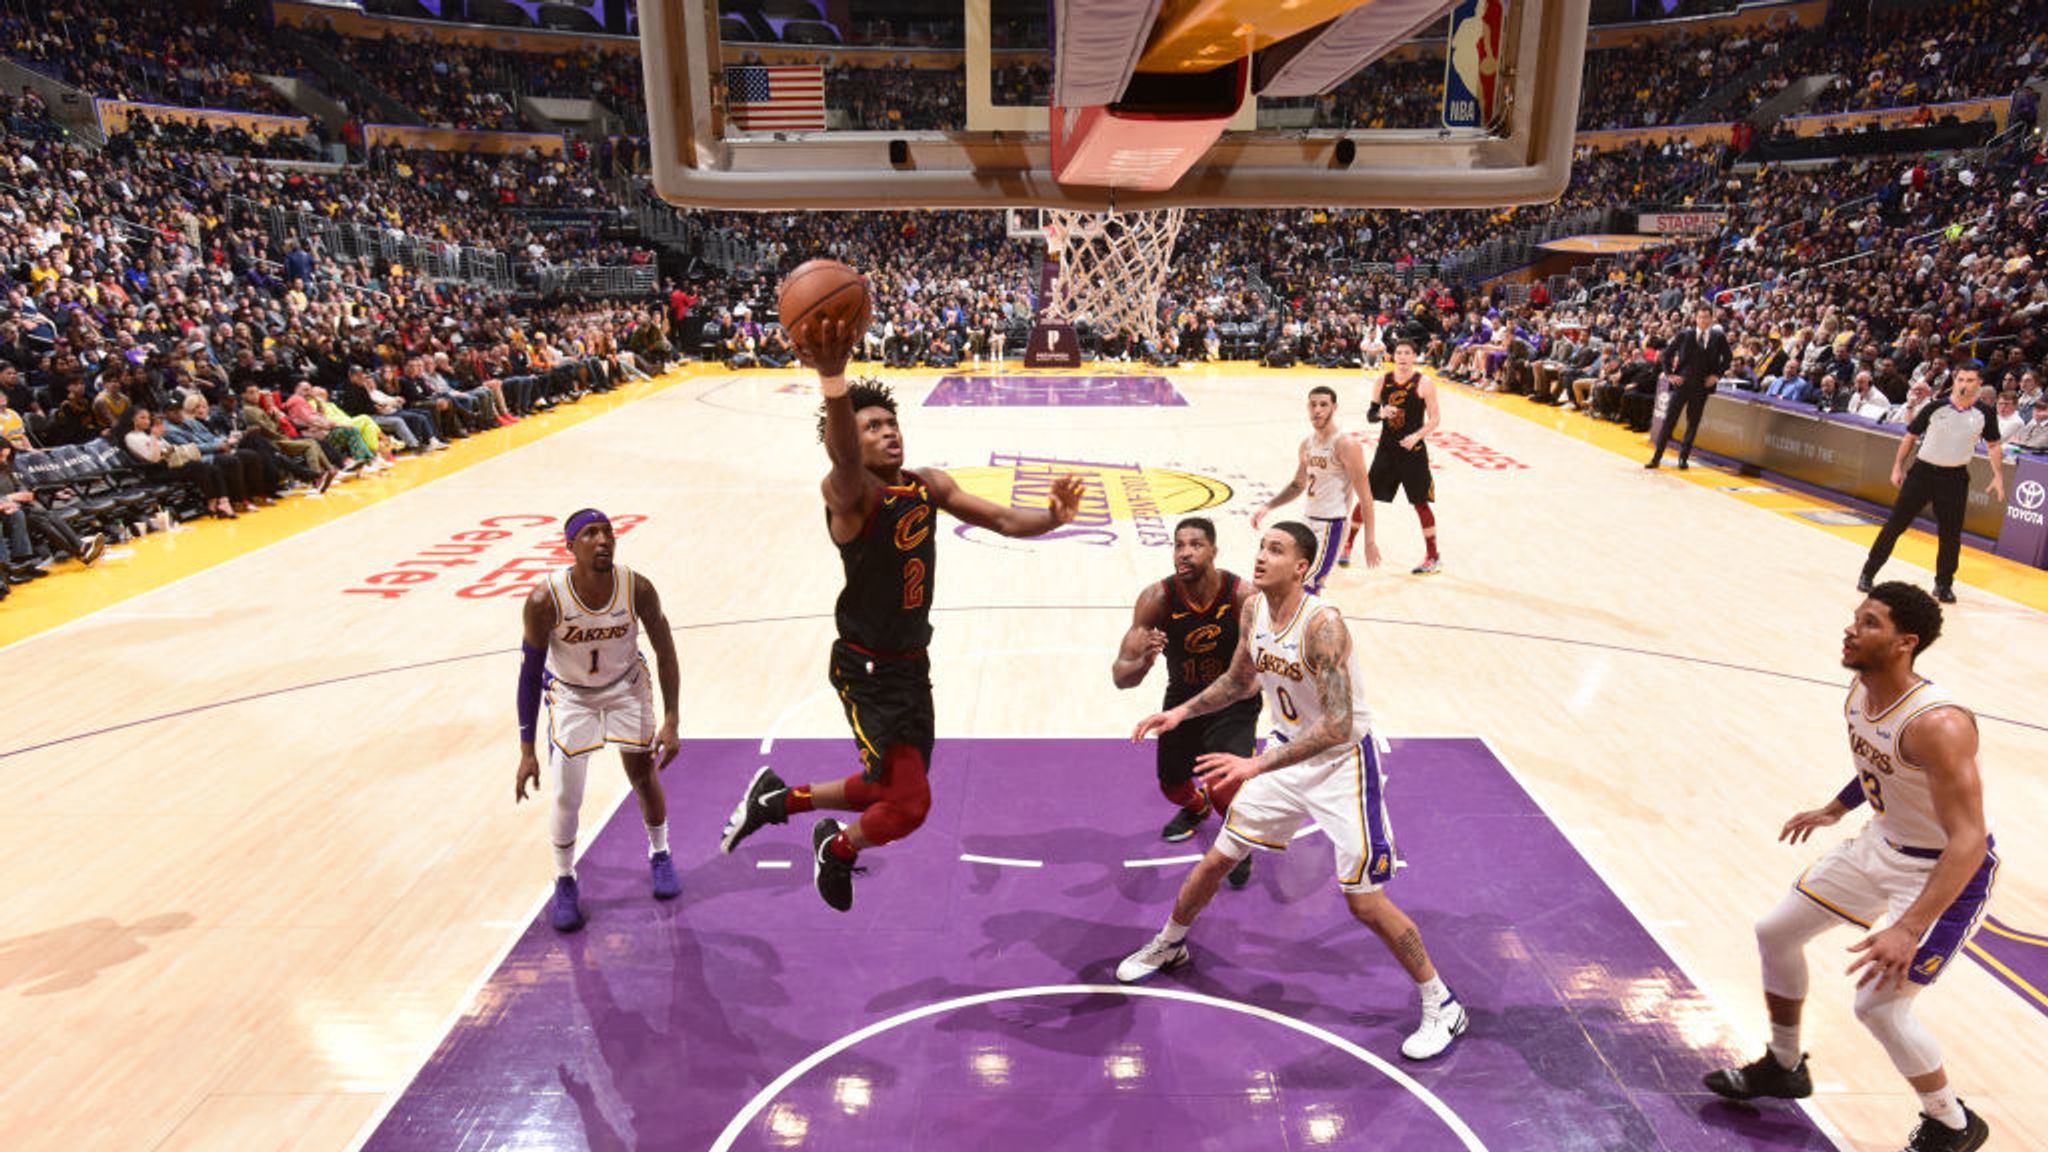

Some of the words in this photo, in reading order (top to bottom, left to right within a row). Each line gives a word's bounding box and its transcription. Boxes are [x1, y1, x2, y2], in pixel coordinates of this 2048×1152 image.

[1450, 100, 1475, 121] NBA
[2007, 506, 2044, 526] TOYOTA
[342, 514, 557, 599] Center
[903, 556, 925, 609] 2
[560, 623, 630, 645] LAKERS
[588, 648, 599, 675] 1
[1256, 647, 1303, 682] LAKERS
[1276, 685, 1299, 724] 0
[1860, 768, 1886, 815] 3
